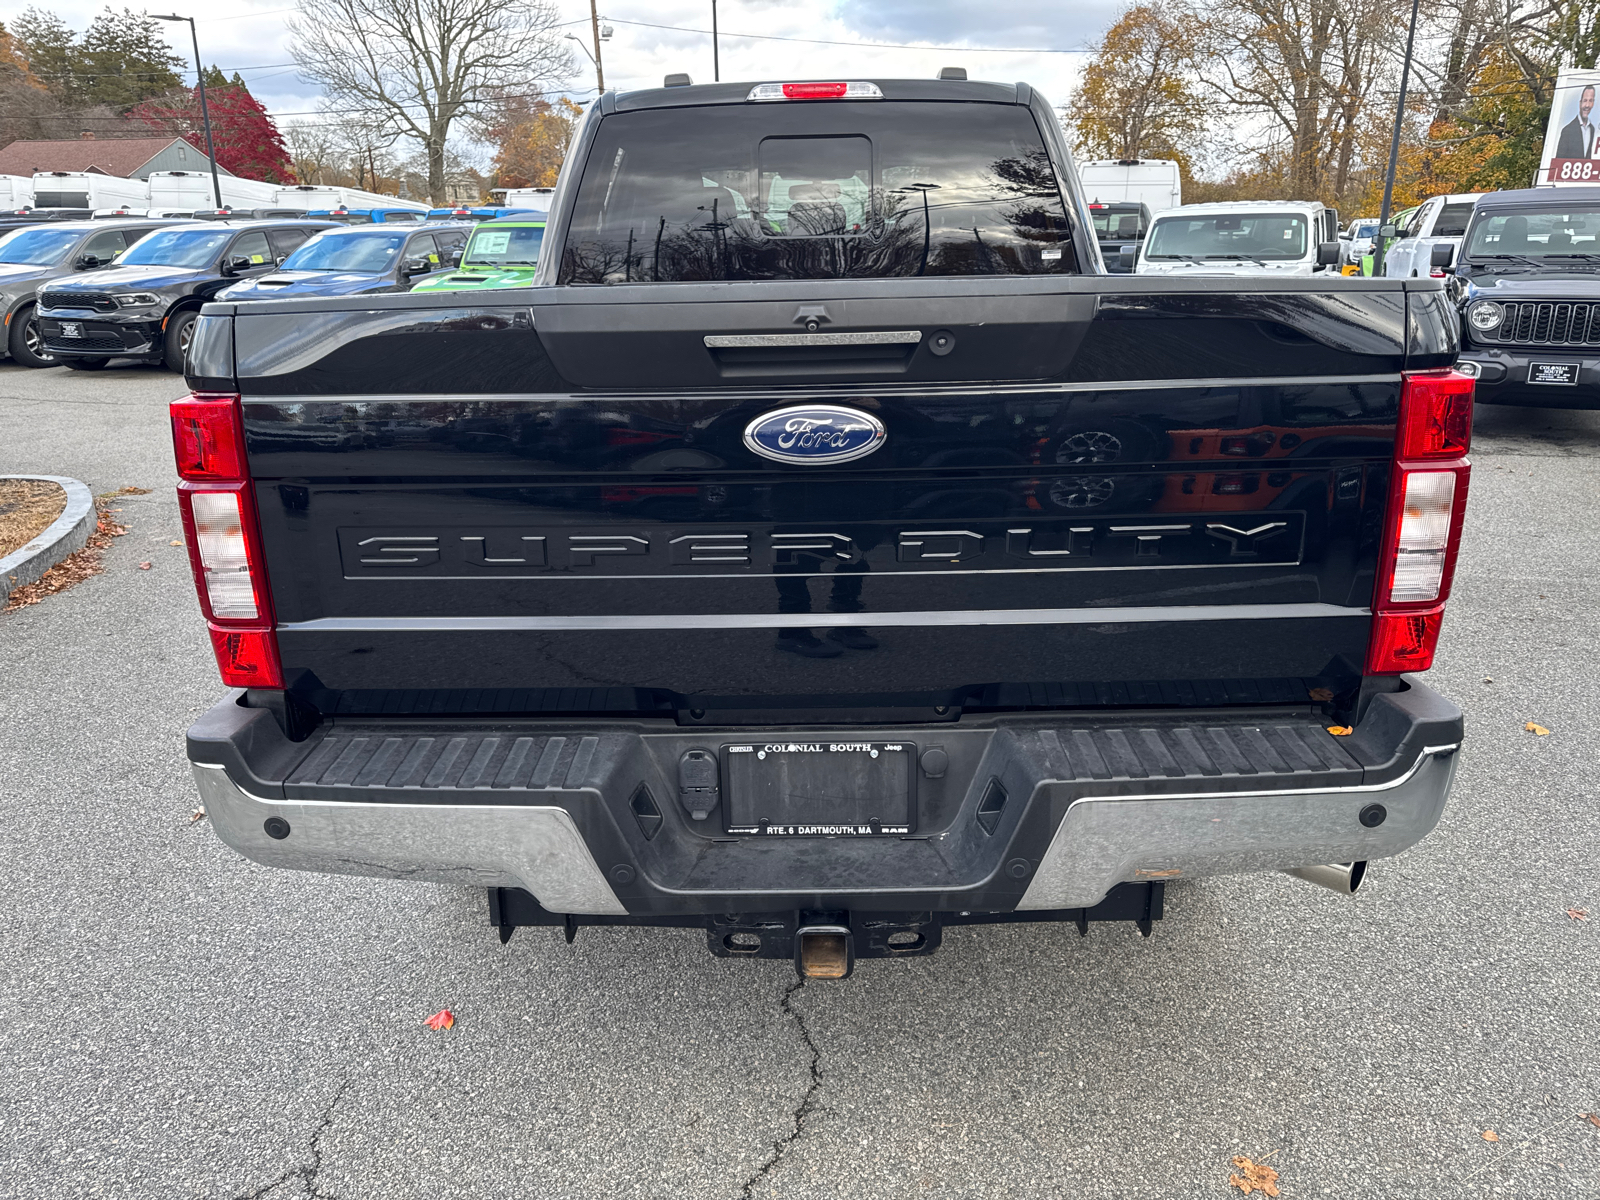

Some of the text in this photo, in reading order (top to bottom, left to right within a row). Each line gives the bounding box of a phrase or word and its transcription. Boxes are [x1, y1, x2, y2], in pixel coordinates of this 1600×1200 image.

[1561, 161, 1600, 180] 888-
[777, 417, 850, 449] Ford
[357, 521, 1288, 567] SUPER DUTY
[764, 743, 872, 753] COLONIAL SOUTH
[884, 744, 903, 752] Jeep
[766, 826, 787, 835] RTE.
[788, 826, 795, 834] 6
[798, 826, 857, 836] DARTMOUTH,
[858, 826, 872, 834] MA
